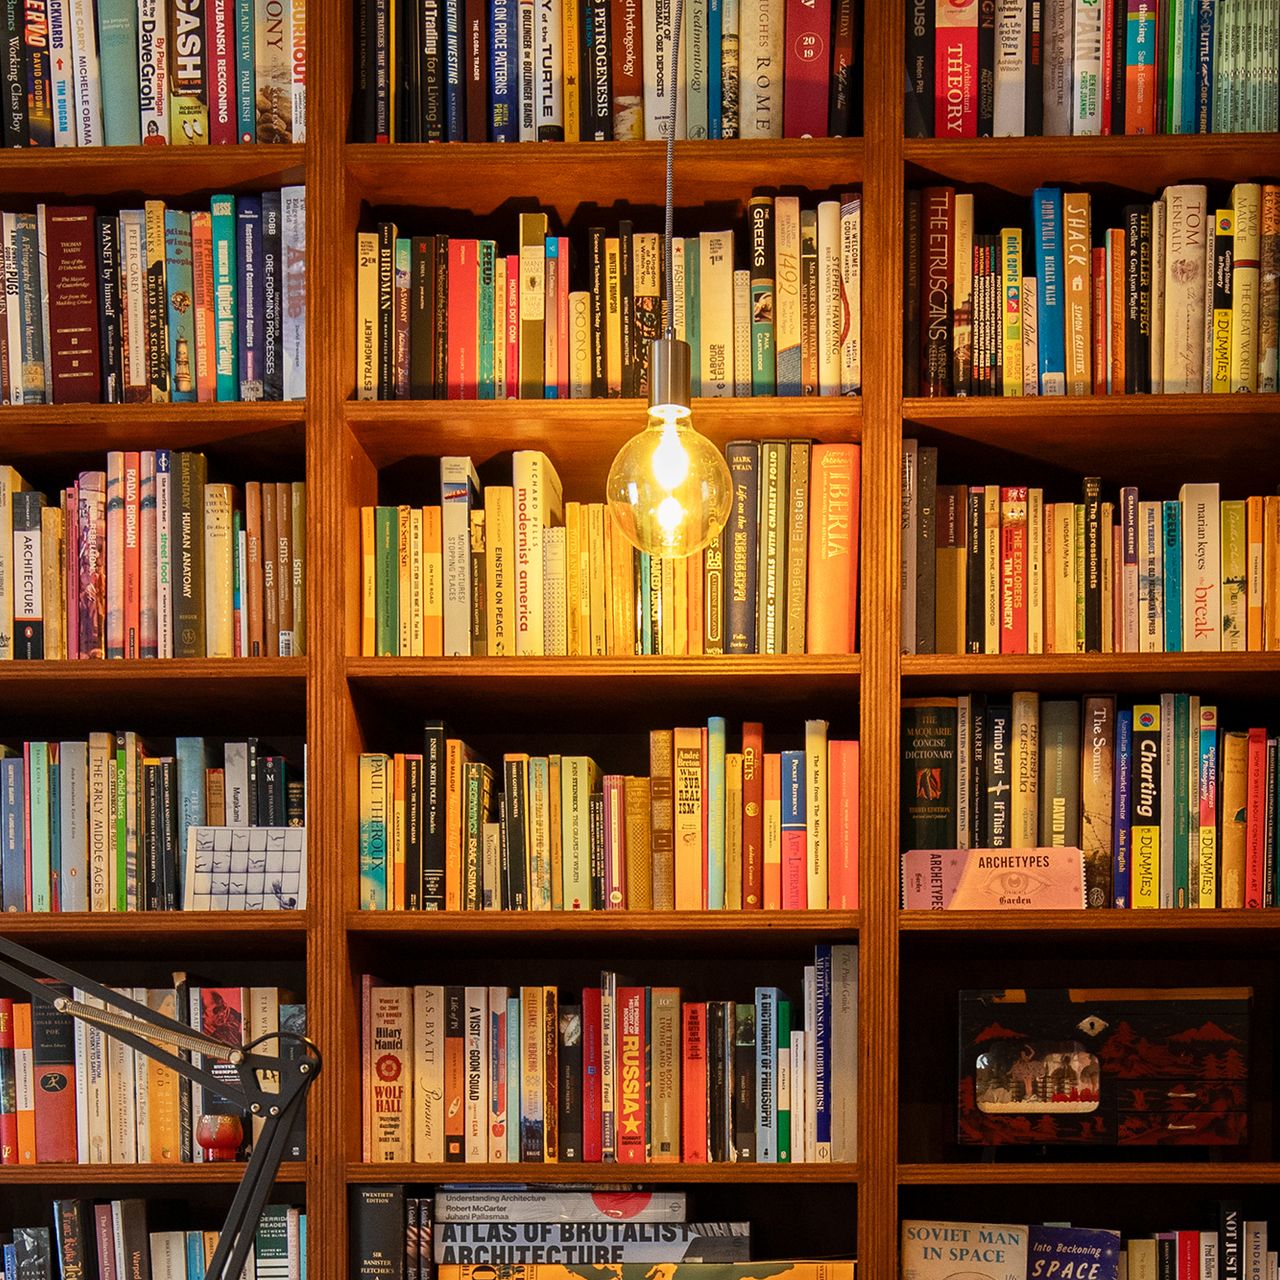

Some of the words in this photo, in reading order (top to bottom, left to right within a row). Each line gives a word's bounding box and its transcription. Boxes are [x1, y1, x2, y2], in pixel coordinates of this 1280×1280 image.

[79, 56, 89, 105] MICHELLE
[595, 8, 608, 116] PETROGENESIS
[216, 60, 228, 123] RECKONING
[755, 56, 771, 130] ROME
[947, 44, 963, 132] THEORY
[82, 107, 92, 144] OBAMA
[930, 196, 948, 229] THE
[102, 224, 114, 266] MANET
[753, 209, 766, 266] GREEKS
[1068, 205, 1086, 265] SHACK
[101, 269, 113, 280] by
[265, 254, 275, 317] ORE-FORMING
[779, 251, 799, 295] 1492
[830, 256, 839, 301] STEPHEN
[929, 233, 947, 339] ETRUSCANS
[103, 283, 115, 316] himself
[265, 321, 275, 374] PROCESSES
[831, 305, 840, 355] HAWKING
[1215, 319, 1229, 382] DUMMIES
[182, 512, 191, 548] HUMAN
[518, 488, 530, 566] modernist
[1013, 529, 1022, 549] THE
[1196, 503, 1207, 539] marian
[23, 536, 34, 614] ARCHITECTURE
[182, 552, 192, 597] ANATOMY
[1195, 542, 1208, 569] keyes
[519, 570, 531, 632] america
[1014, 552, 1023, 608] EXPLORERS
[1193, 586, 1215, 639] break
[993, 718, 1004, 749] Primo
[993, 752, 1005, 774] Levi
[1136, 739, 1157, 817] Charting
[993, 812, 1005, 833] This
[994, 801, 1005, 809] If
[979, 856, 1050, 867] ARCHETYPES
[994, 836, 1005, 846] is
[931, 854, 944, 909] ARCHETYPES
[1139, 835, 1155, 896] DUMMIES
[374, 1086, 403, 1098] WOLF
[623, 1036, 642, 1114] RUSSIA
[375, 1100, 403, 1112] HALL
[441, 1222, 517, 1243] ATLAS
[524, 1222, 552, 1243] OF
[559, 1221, 689, 1242] BRUTALIST
[907, 1227, 971, 1245] SOVIET
[978, 1230, 1020, 1247] MAN
[1225, 1211, 1237, 1238] NOT
[441, 1245, 624, 1264] ARCHITECTURE
[923, 1247, 943, 1260] IN
[948, 1249, 1005, 1264] SPACE
[1032, 1261, 1101, 1280] SPACE
[1033, 1242, 1052, 1253] Into
[1055, 1244, 1102, 1258] Beckoning
[1225, 1242, 1237, 1273] JUST
